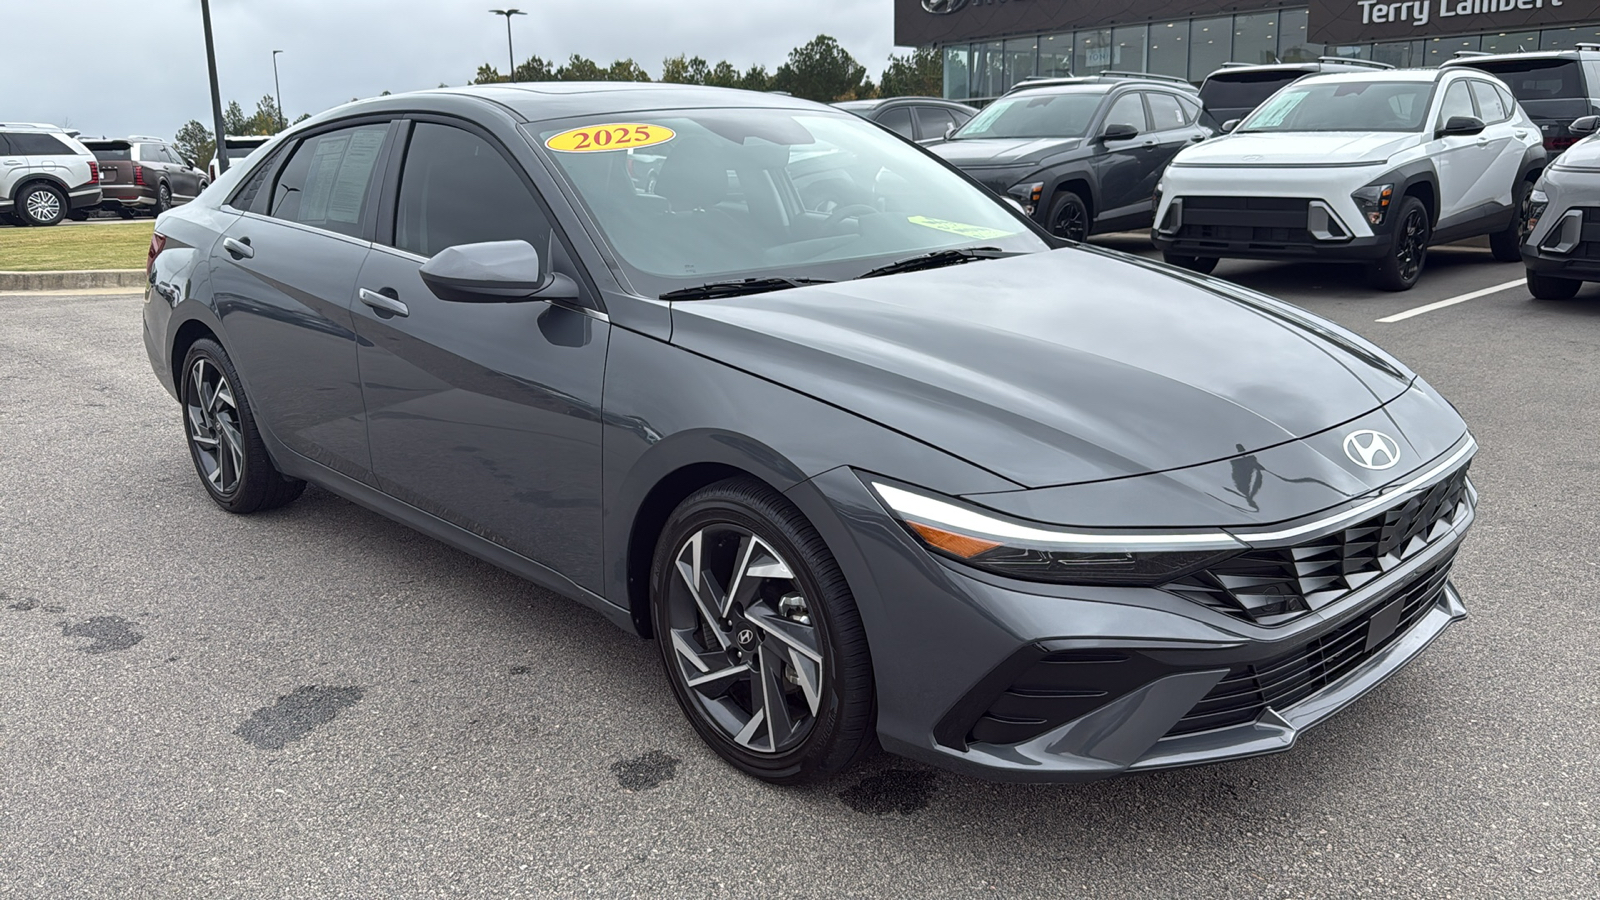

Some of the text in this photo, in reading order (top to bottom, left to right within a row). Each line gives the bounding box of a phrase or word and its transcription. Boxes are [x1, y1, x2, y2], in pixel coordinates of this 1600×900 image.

[1357, 0, 1563, 26] Terry Lambe
[572, 126, 650, 150] 2025
